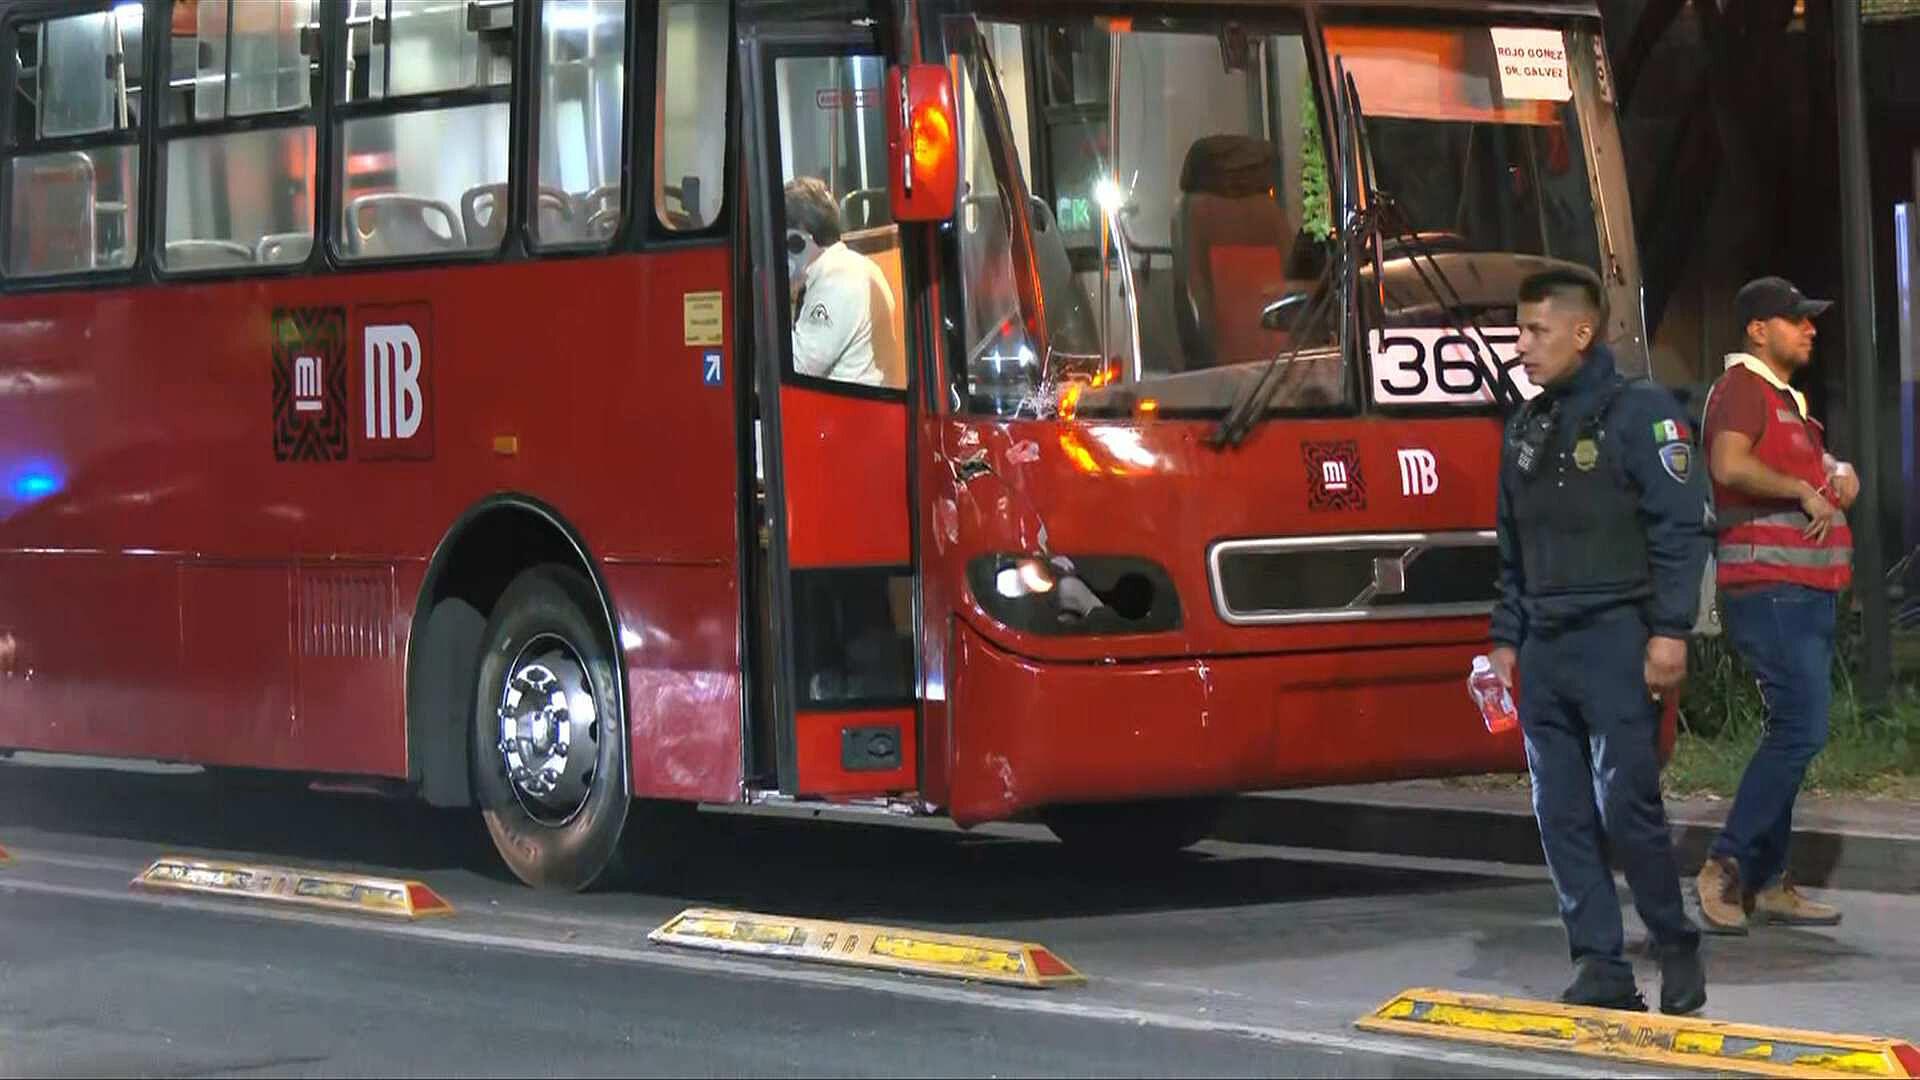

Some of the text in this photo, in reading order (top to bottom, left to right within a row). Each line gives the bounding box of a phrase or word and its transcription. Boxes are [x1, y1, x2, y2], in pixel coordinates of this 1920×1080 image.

[1498, 47, 1525, 57] ROJO
[364, 325, 423, 439] MB
[1398, 449, 1439, 496] MB
